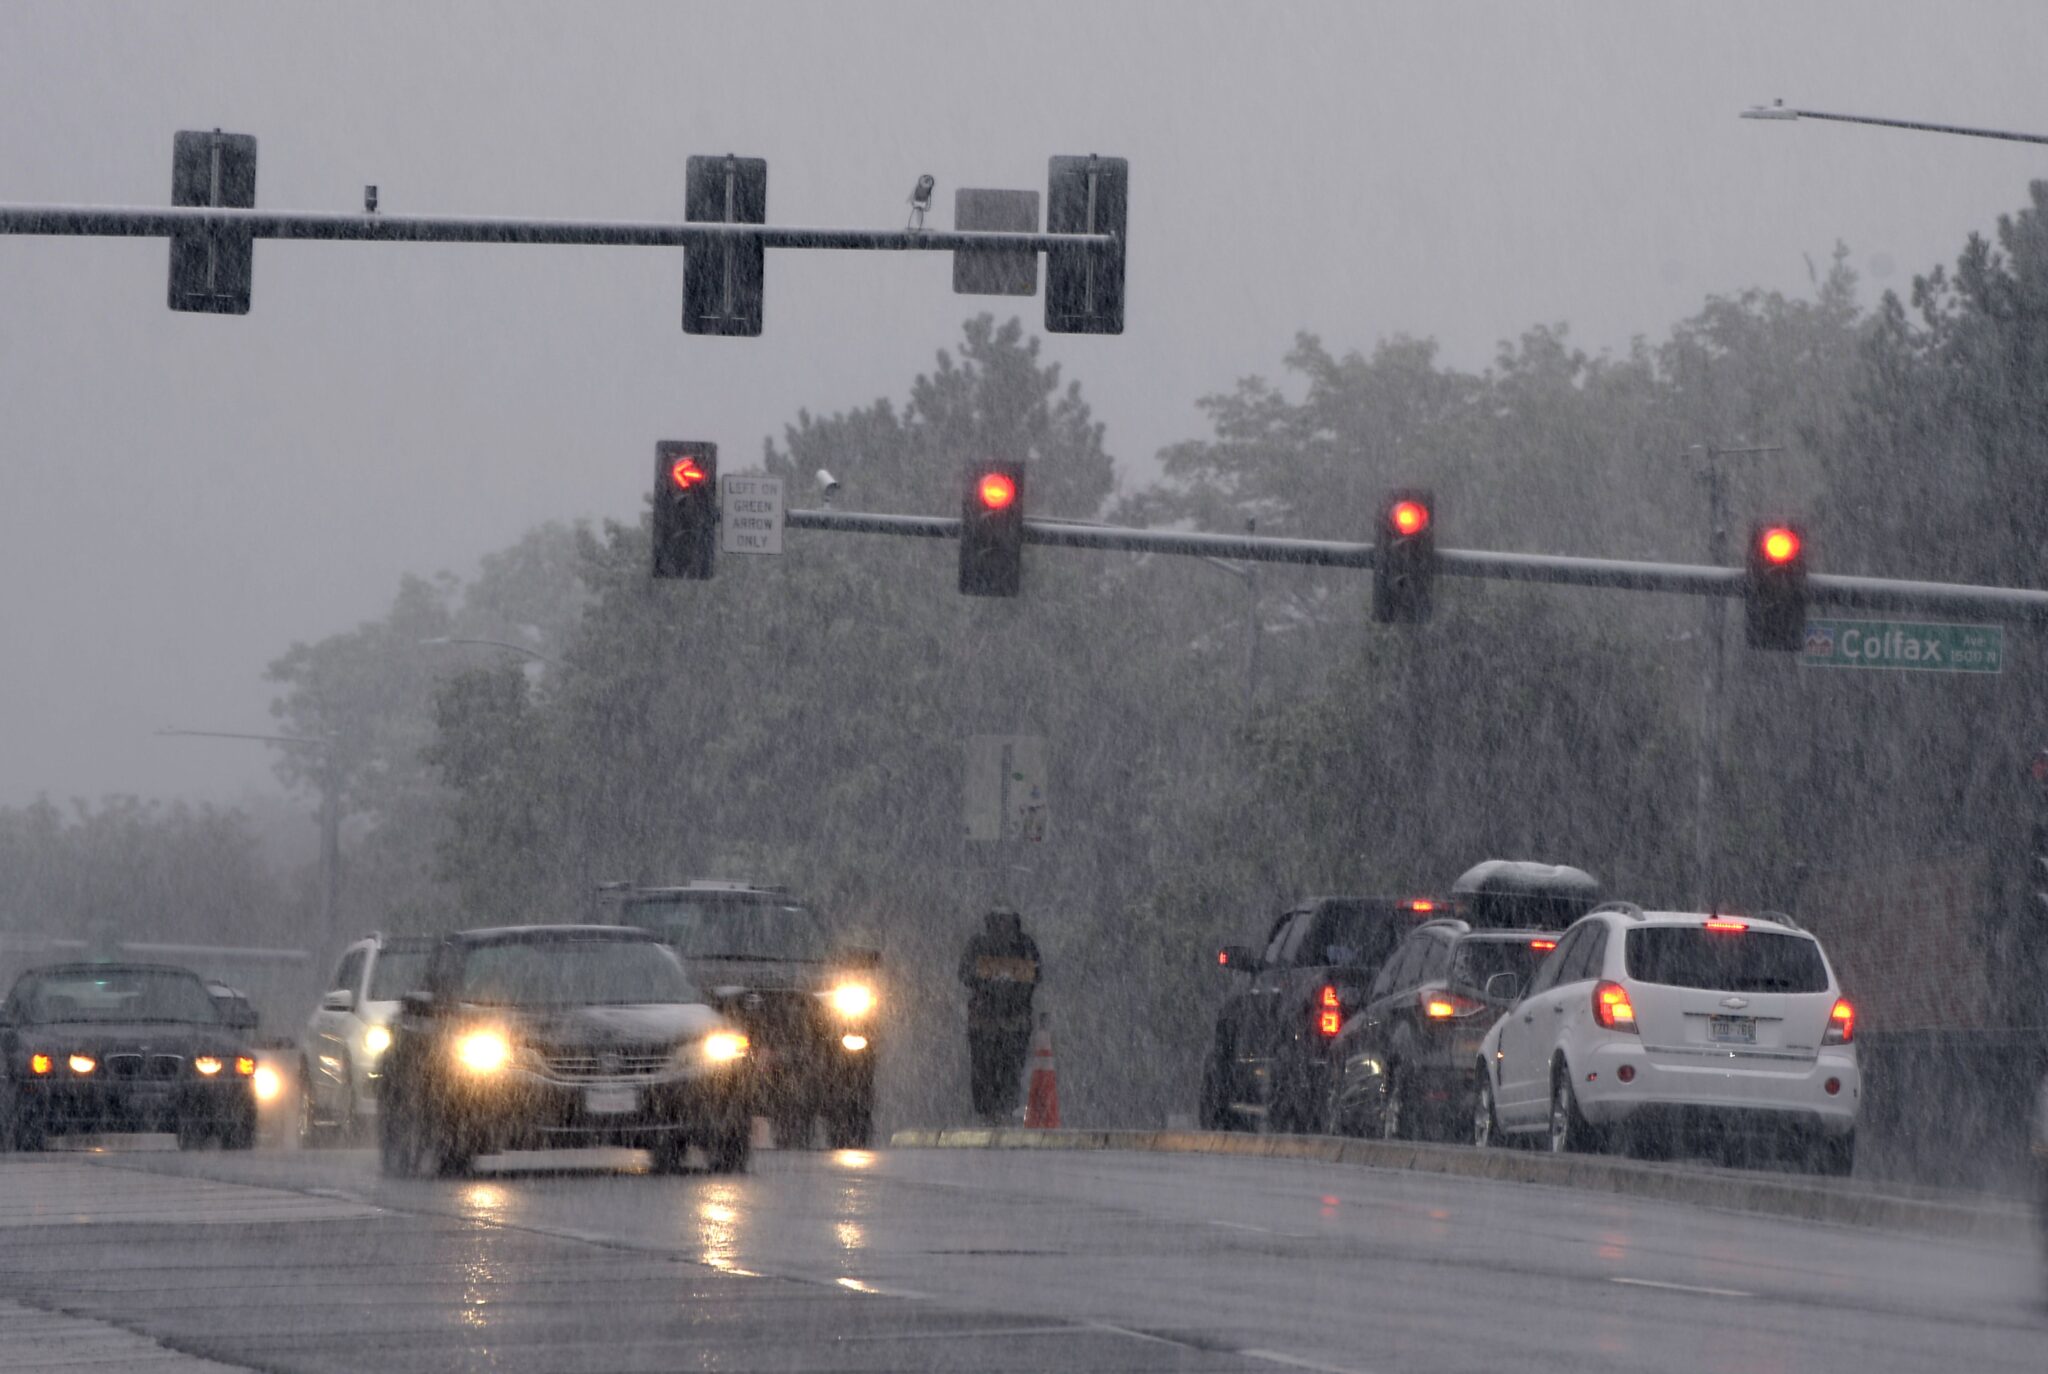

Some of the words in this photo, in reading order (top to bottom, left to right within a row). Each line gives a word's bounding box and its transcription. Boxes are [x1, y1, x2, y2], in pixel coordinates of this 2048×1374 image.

[728, 481, 756, 494] LEFT
[761, 483, 778, 495] ON
[734, 500, 773, 513] GREEN
[732, 518, 773, 530] ARROW
[736, 534, 768, 548] ONLY
[1841, 629, 1943, 662] Colfax
[1962, 635, 1987, 647] Ave
